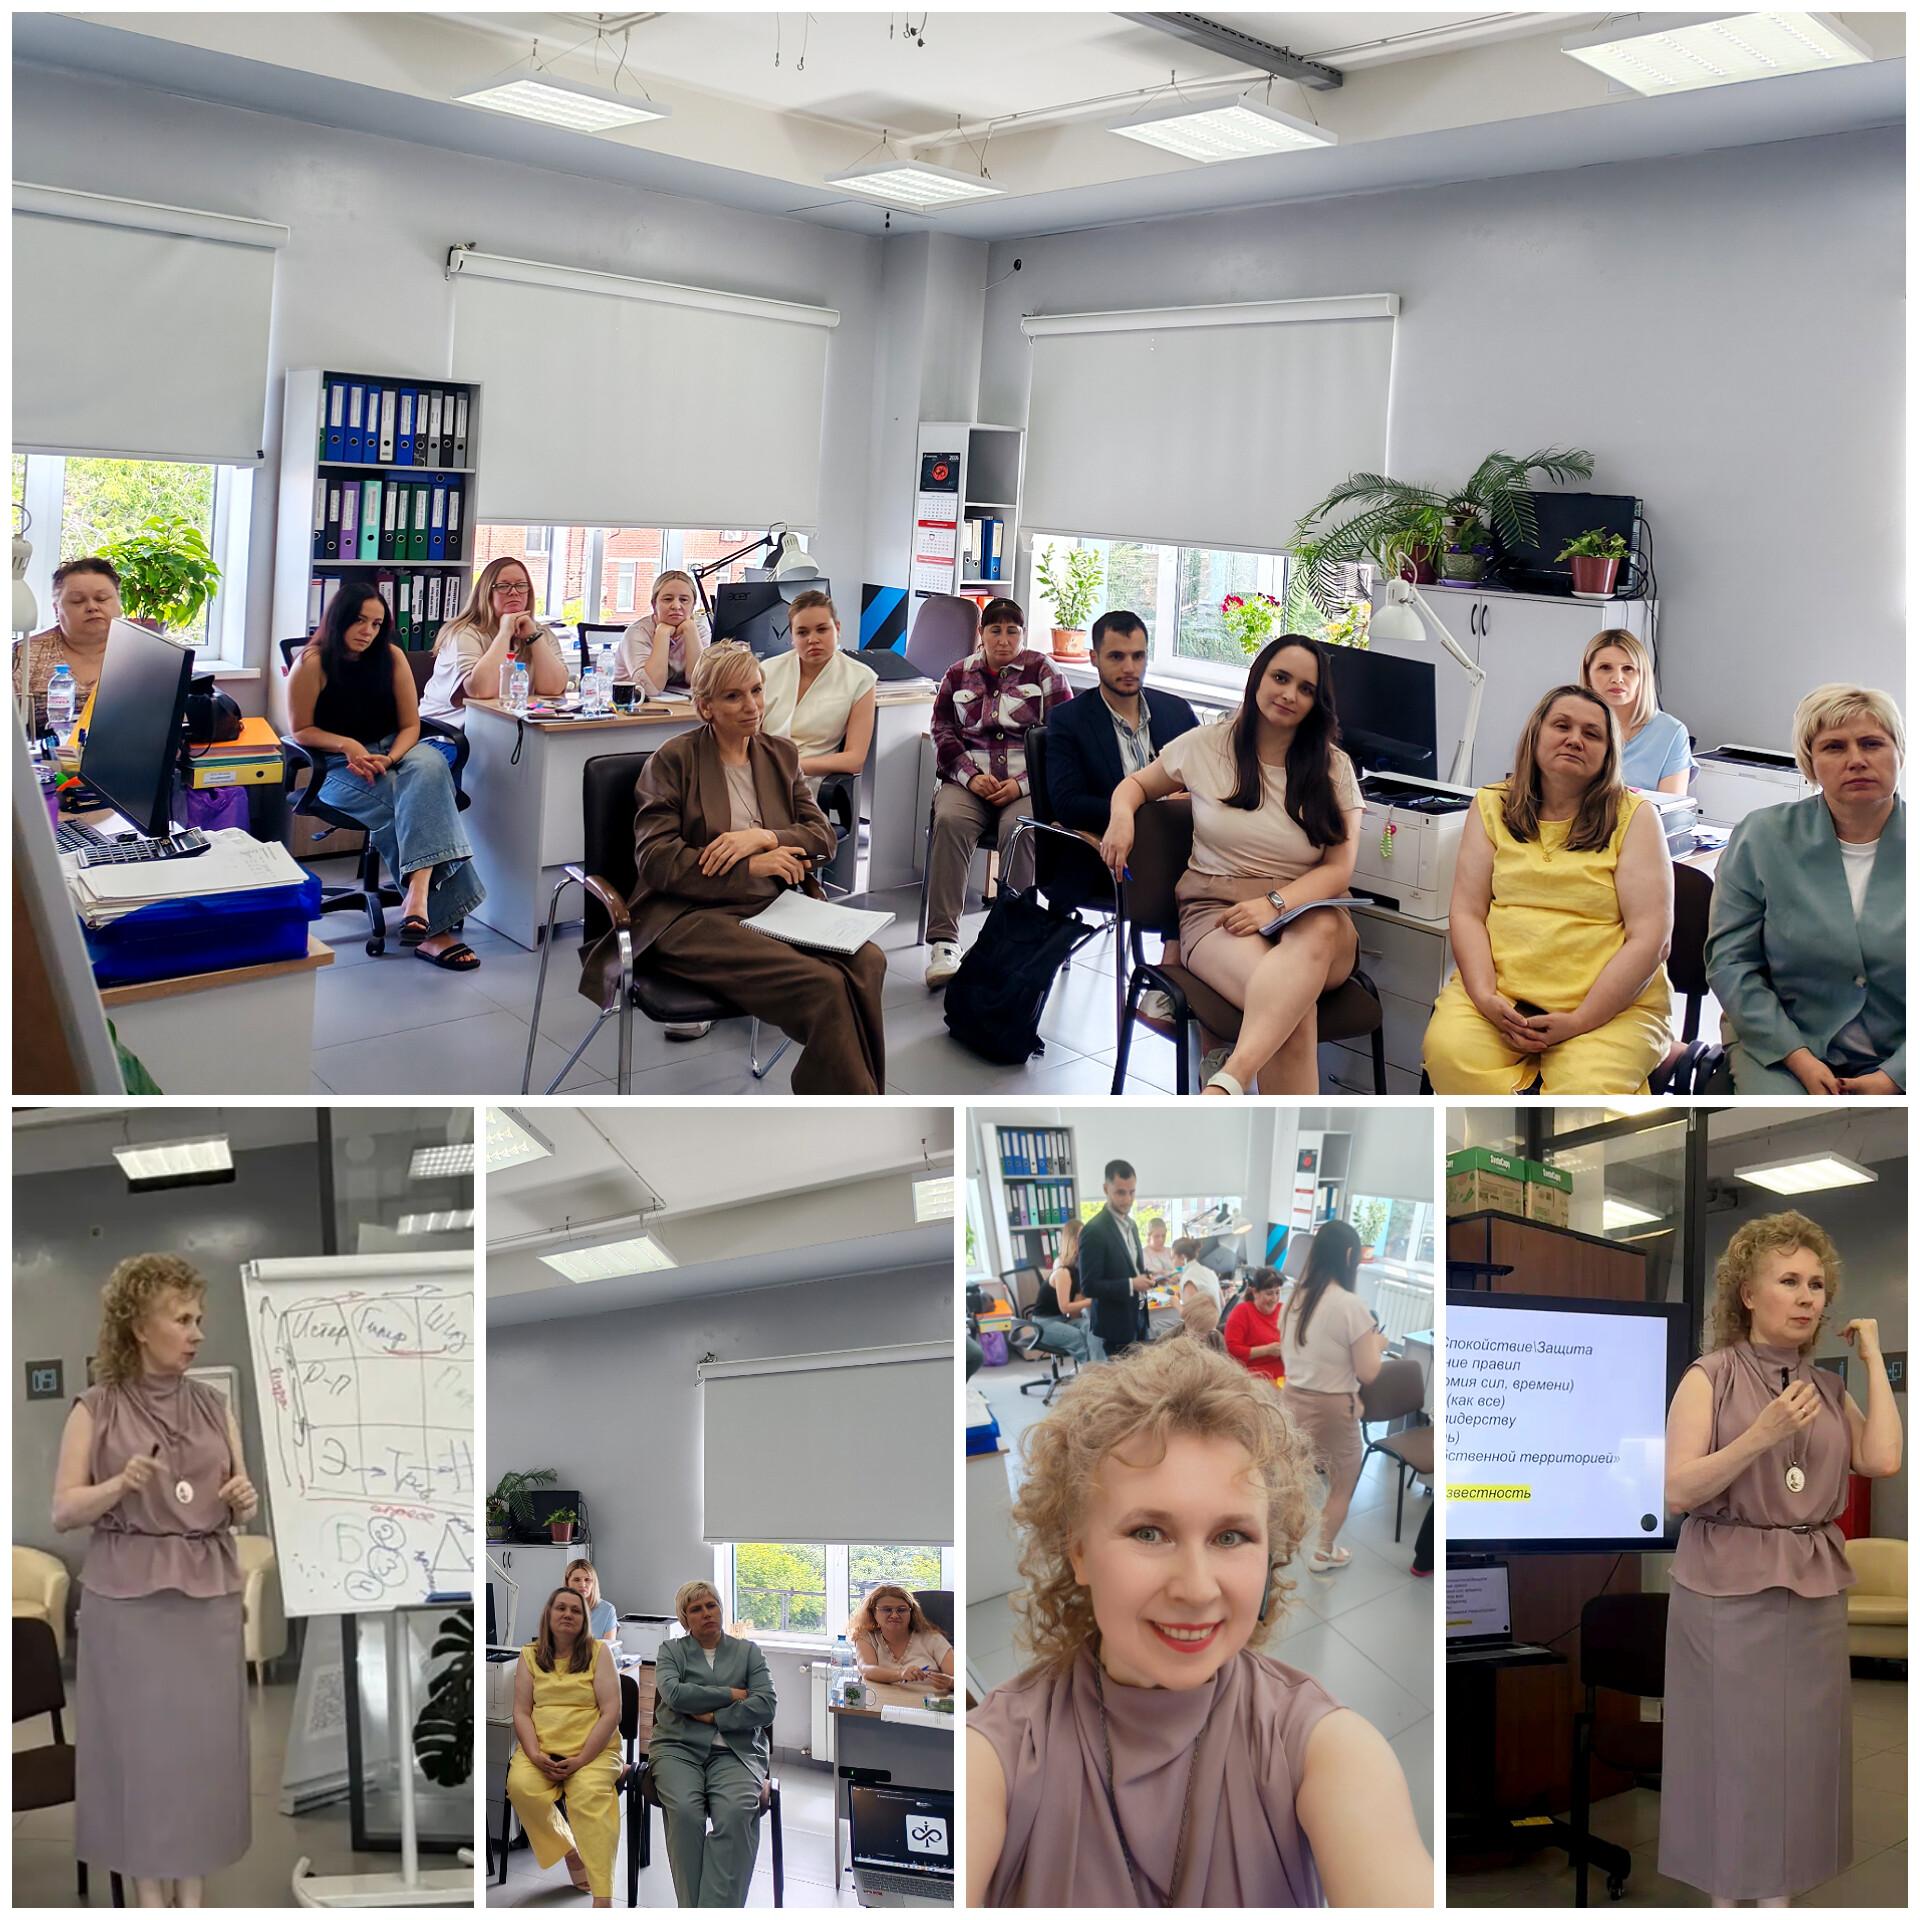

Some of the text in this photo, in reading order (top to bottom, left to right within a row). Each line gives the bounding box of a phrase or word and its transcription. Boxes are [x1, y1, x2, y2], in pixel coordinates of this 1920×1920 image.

[727, 592, 751, 601] acer
[1472, 1359, 1521, 1372] правил
[1481, 1378, 1508, 1389] сил,
[1512, 1380, 1575, 1393] времени)
[1447, 1394, 1505, 1409] (как все)
[1446, 1431, 1460, 1445] ь)
[1446, 1449, 1621, 1465] ственной территорией»
[1446, 1488, 1532, 1499] звестность
